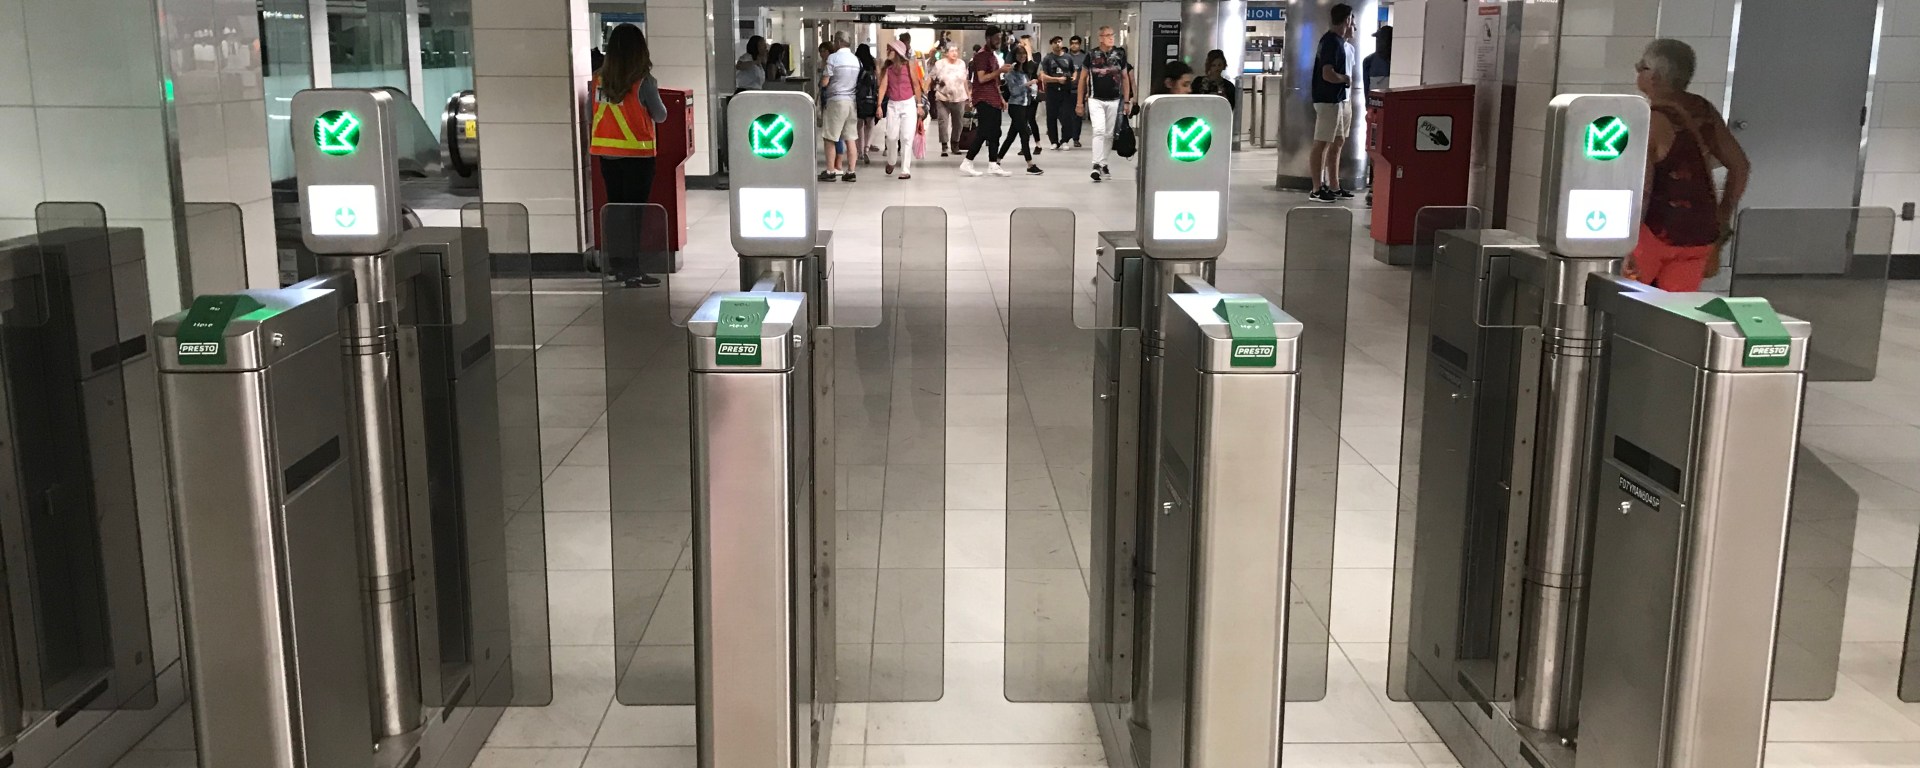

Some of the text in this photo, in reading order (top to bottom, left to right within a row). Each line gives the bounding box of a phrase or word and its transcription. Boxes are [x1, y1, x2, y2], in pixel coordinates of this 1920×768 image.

[1421, 121, 1436, 132] POP
[721, 345, 755, 353] PRESTO
[1238, 347, 1271, 355] PRESTO
